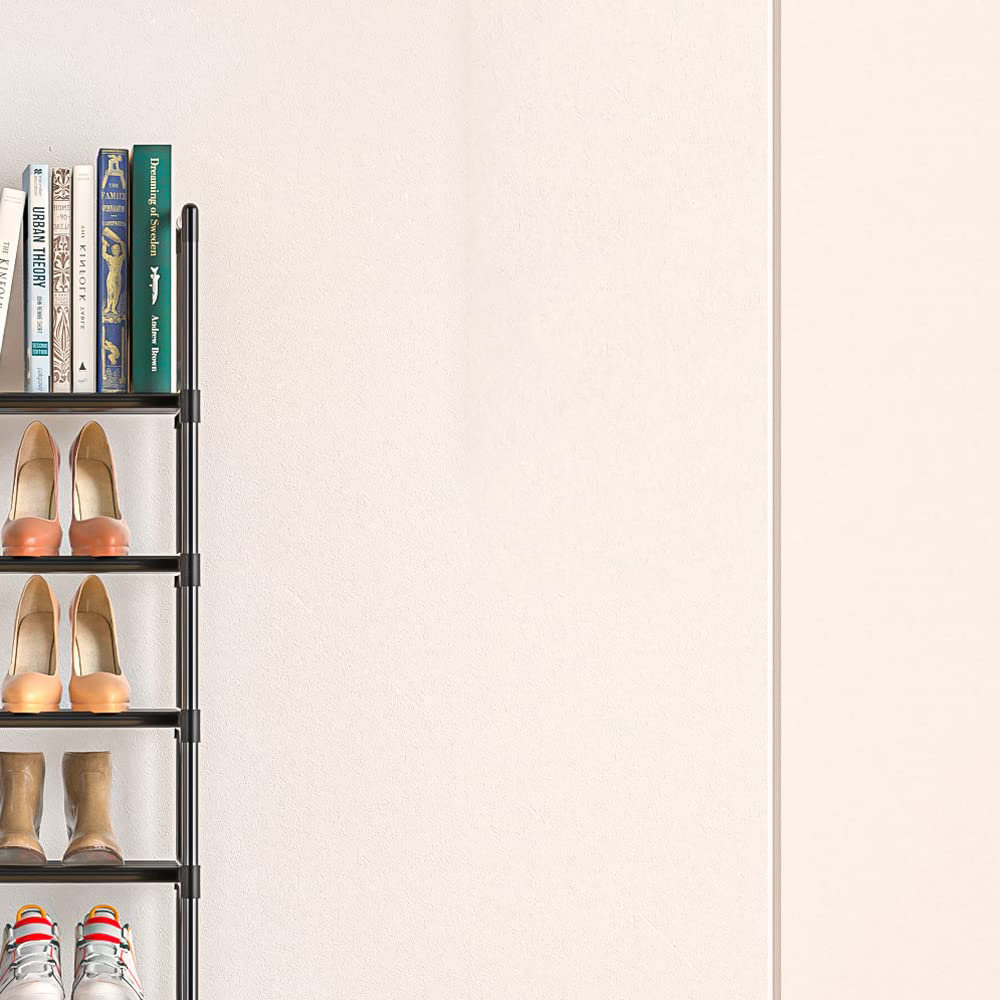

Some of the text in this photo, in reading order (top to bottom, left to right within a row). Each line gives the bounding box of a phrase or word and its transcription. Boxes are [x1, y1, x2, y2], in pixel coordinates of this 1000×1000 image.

[147, 157, 160, 257] Dreaming of Sweden
[2, 241, 10, 255] THE
[32, 206, 46, 288] URBAN THEORY
[151, 314, 160, 372] Andrew Brown
